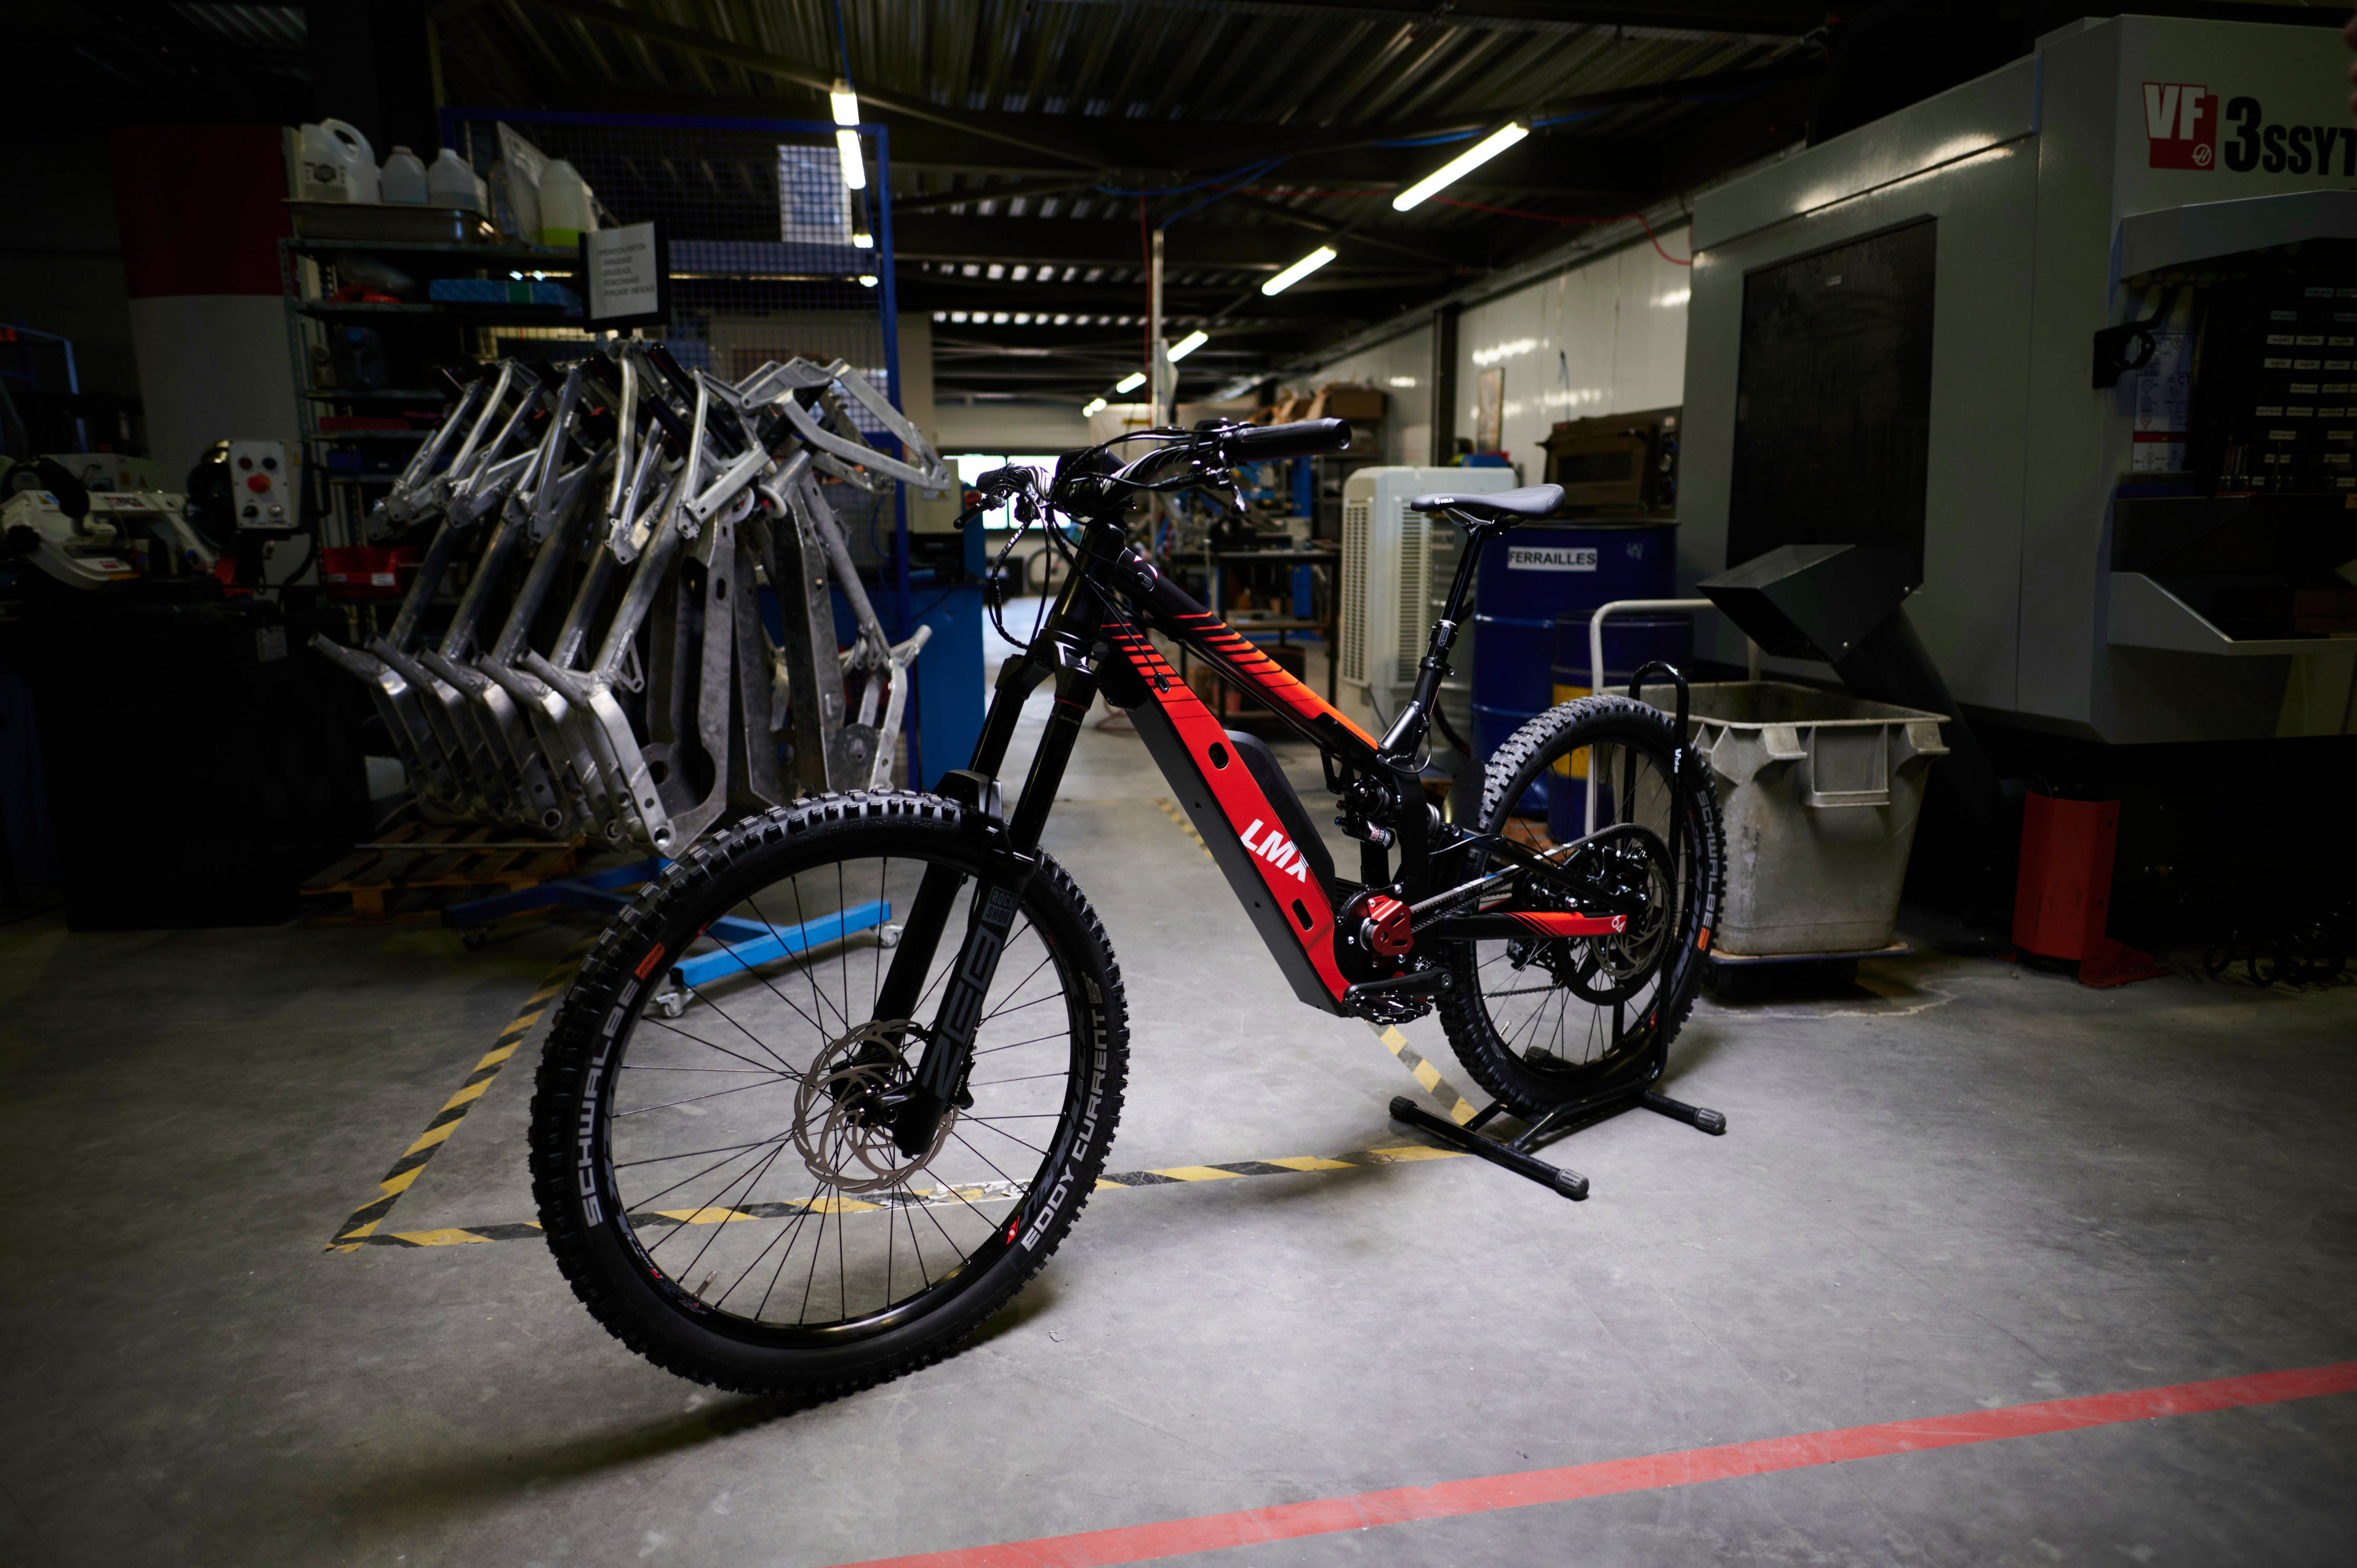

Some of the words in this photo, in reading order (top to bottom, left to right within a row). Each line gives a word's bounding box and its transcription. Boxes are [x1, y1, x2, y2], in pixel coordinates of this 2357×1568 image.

[2144, 82, 2207, 140] VF
[1509, 551, 1596, 566] FERRAILLES
[1240, 818, 1310, 883] LMX
[1697, 791, 1719, 929] SCHWALBE
[986, 906, 1011, 926] SHOX
[990, 891, 1017, 911] ROCK
[922, 924, 1005, 1100] ZEB
[578, 979, 641, 1227] SCHWALBE
[1021, 1163, 1075, 1252] EDDY
[1072, 1009, 1107, 1162] CURRENT
